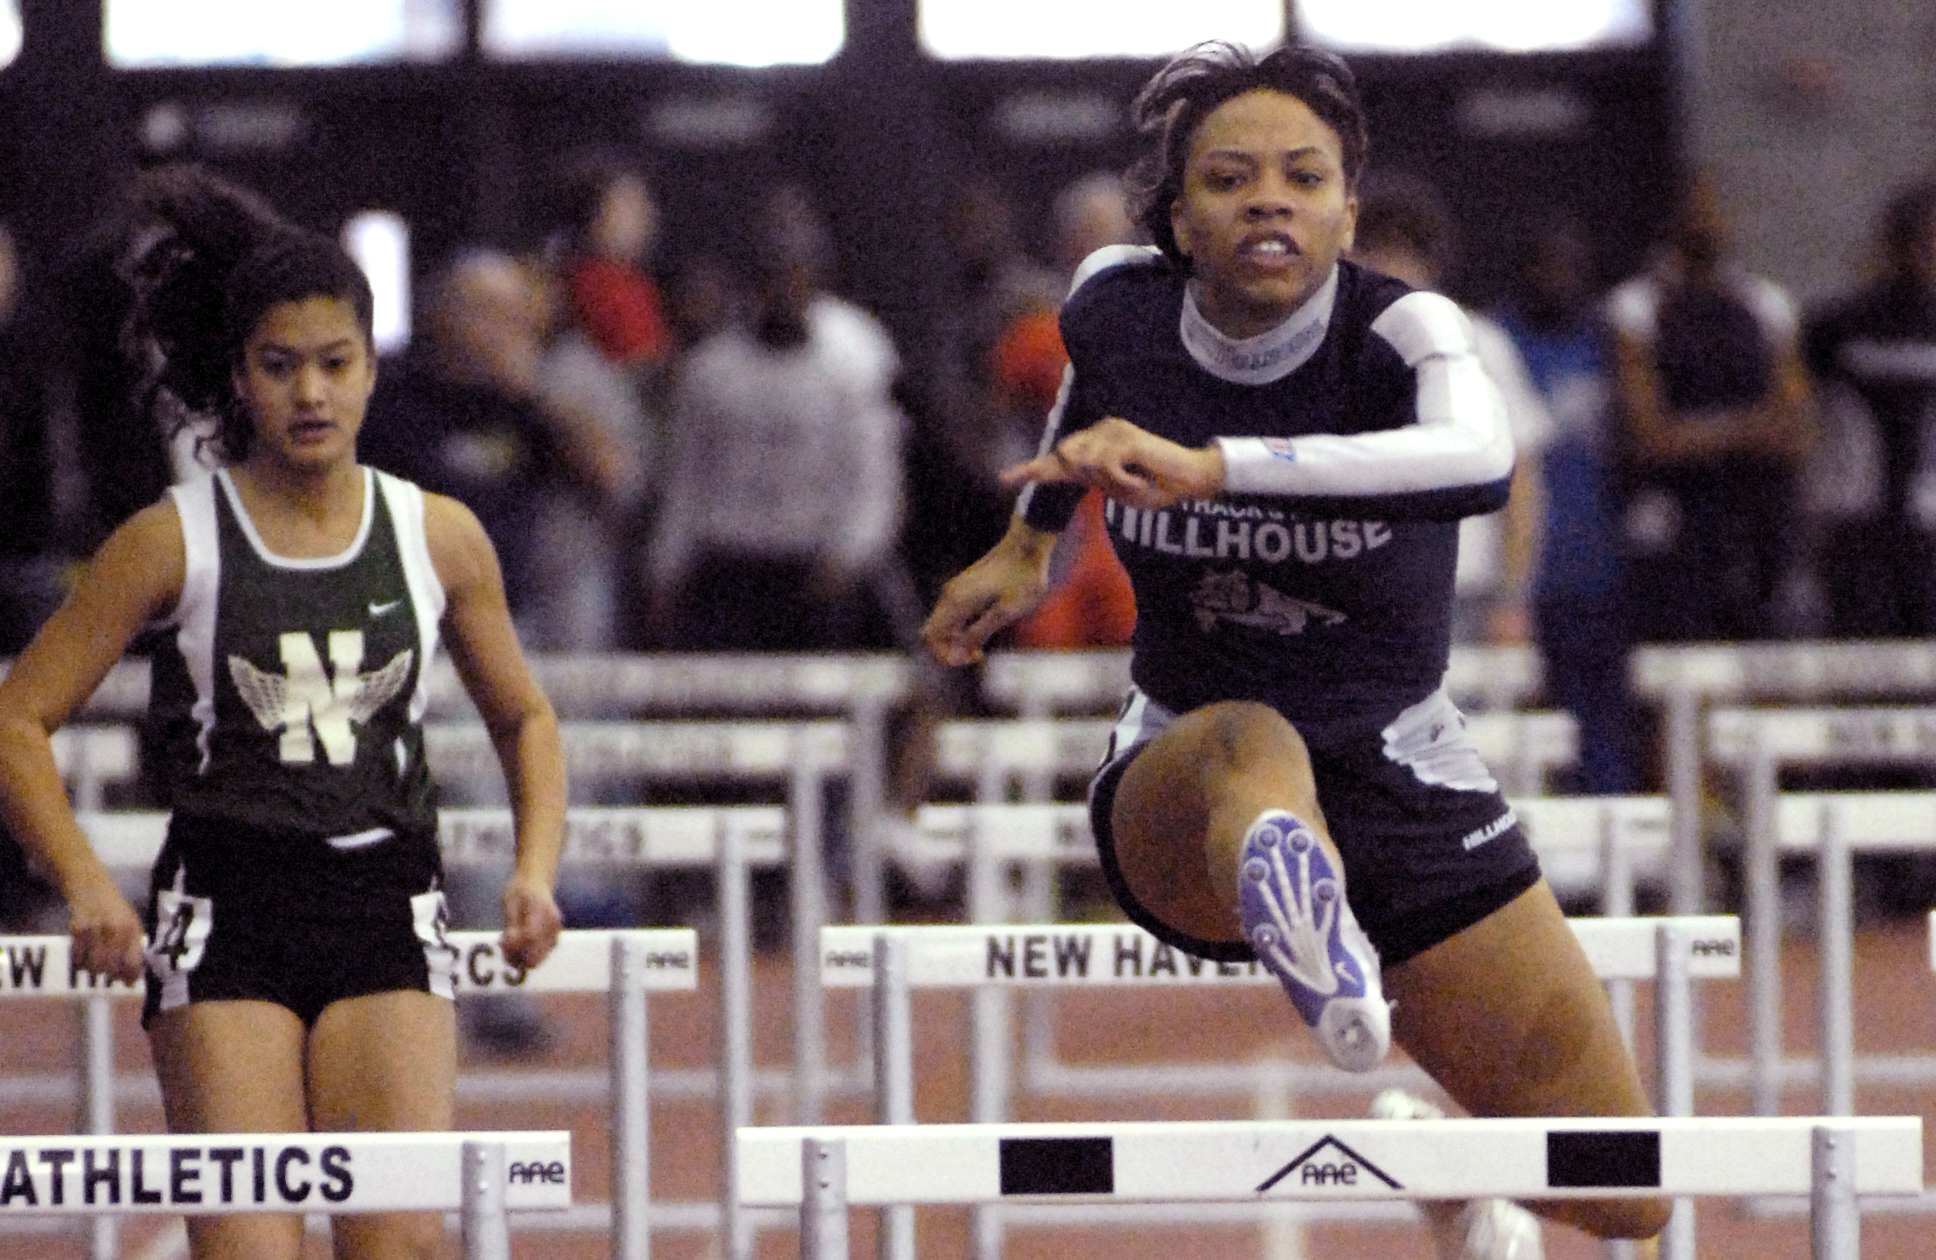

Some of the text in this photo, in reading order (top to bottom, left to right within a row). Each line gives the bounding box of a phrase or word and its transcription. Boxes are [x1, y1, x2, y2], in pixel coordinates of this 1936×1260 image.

[280, 631, 363, 765] N
[987, 934, 1092, 977] NEW
[0, 1146, 354, 1206] ATHLETICS
